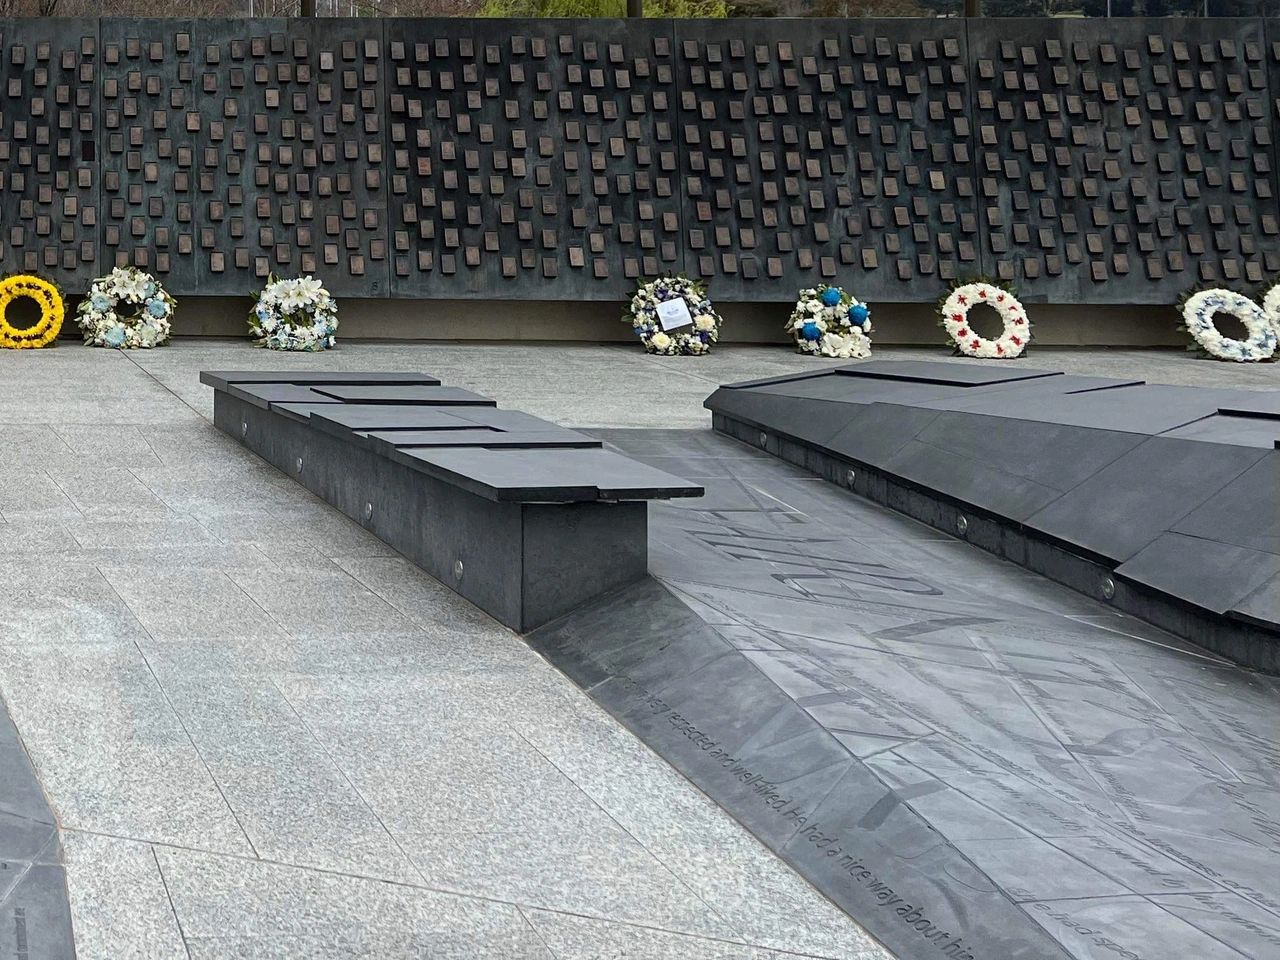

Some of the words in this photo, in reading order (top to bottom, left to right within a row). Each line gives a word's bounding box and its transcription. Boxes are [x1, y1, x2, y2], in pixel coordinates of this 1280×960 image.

[662, 704, 716, 758] respected
[707, 742, 739, 773] and
[779, 802, 808, 830] He
[800, 819, 838, 855] had
[825, 842, 843, 860] a
[837, 851, 874, 886] nice
[862, 876, 902, 914] way
[896, 899, 952, 951] about
